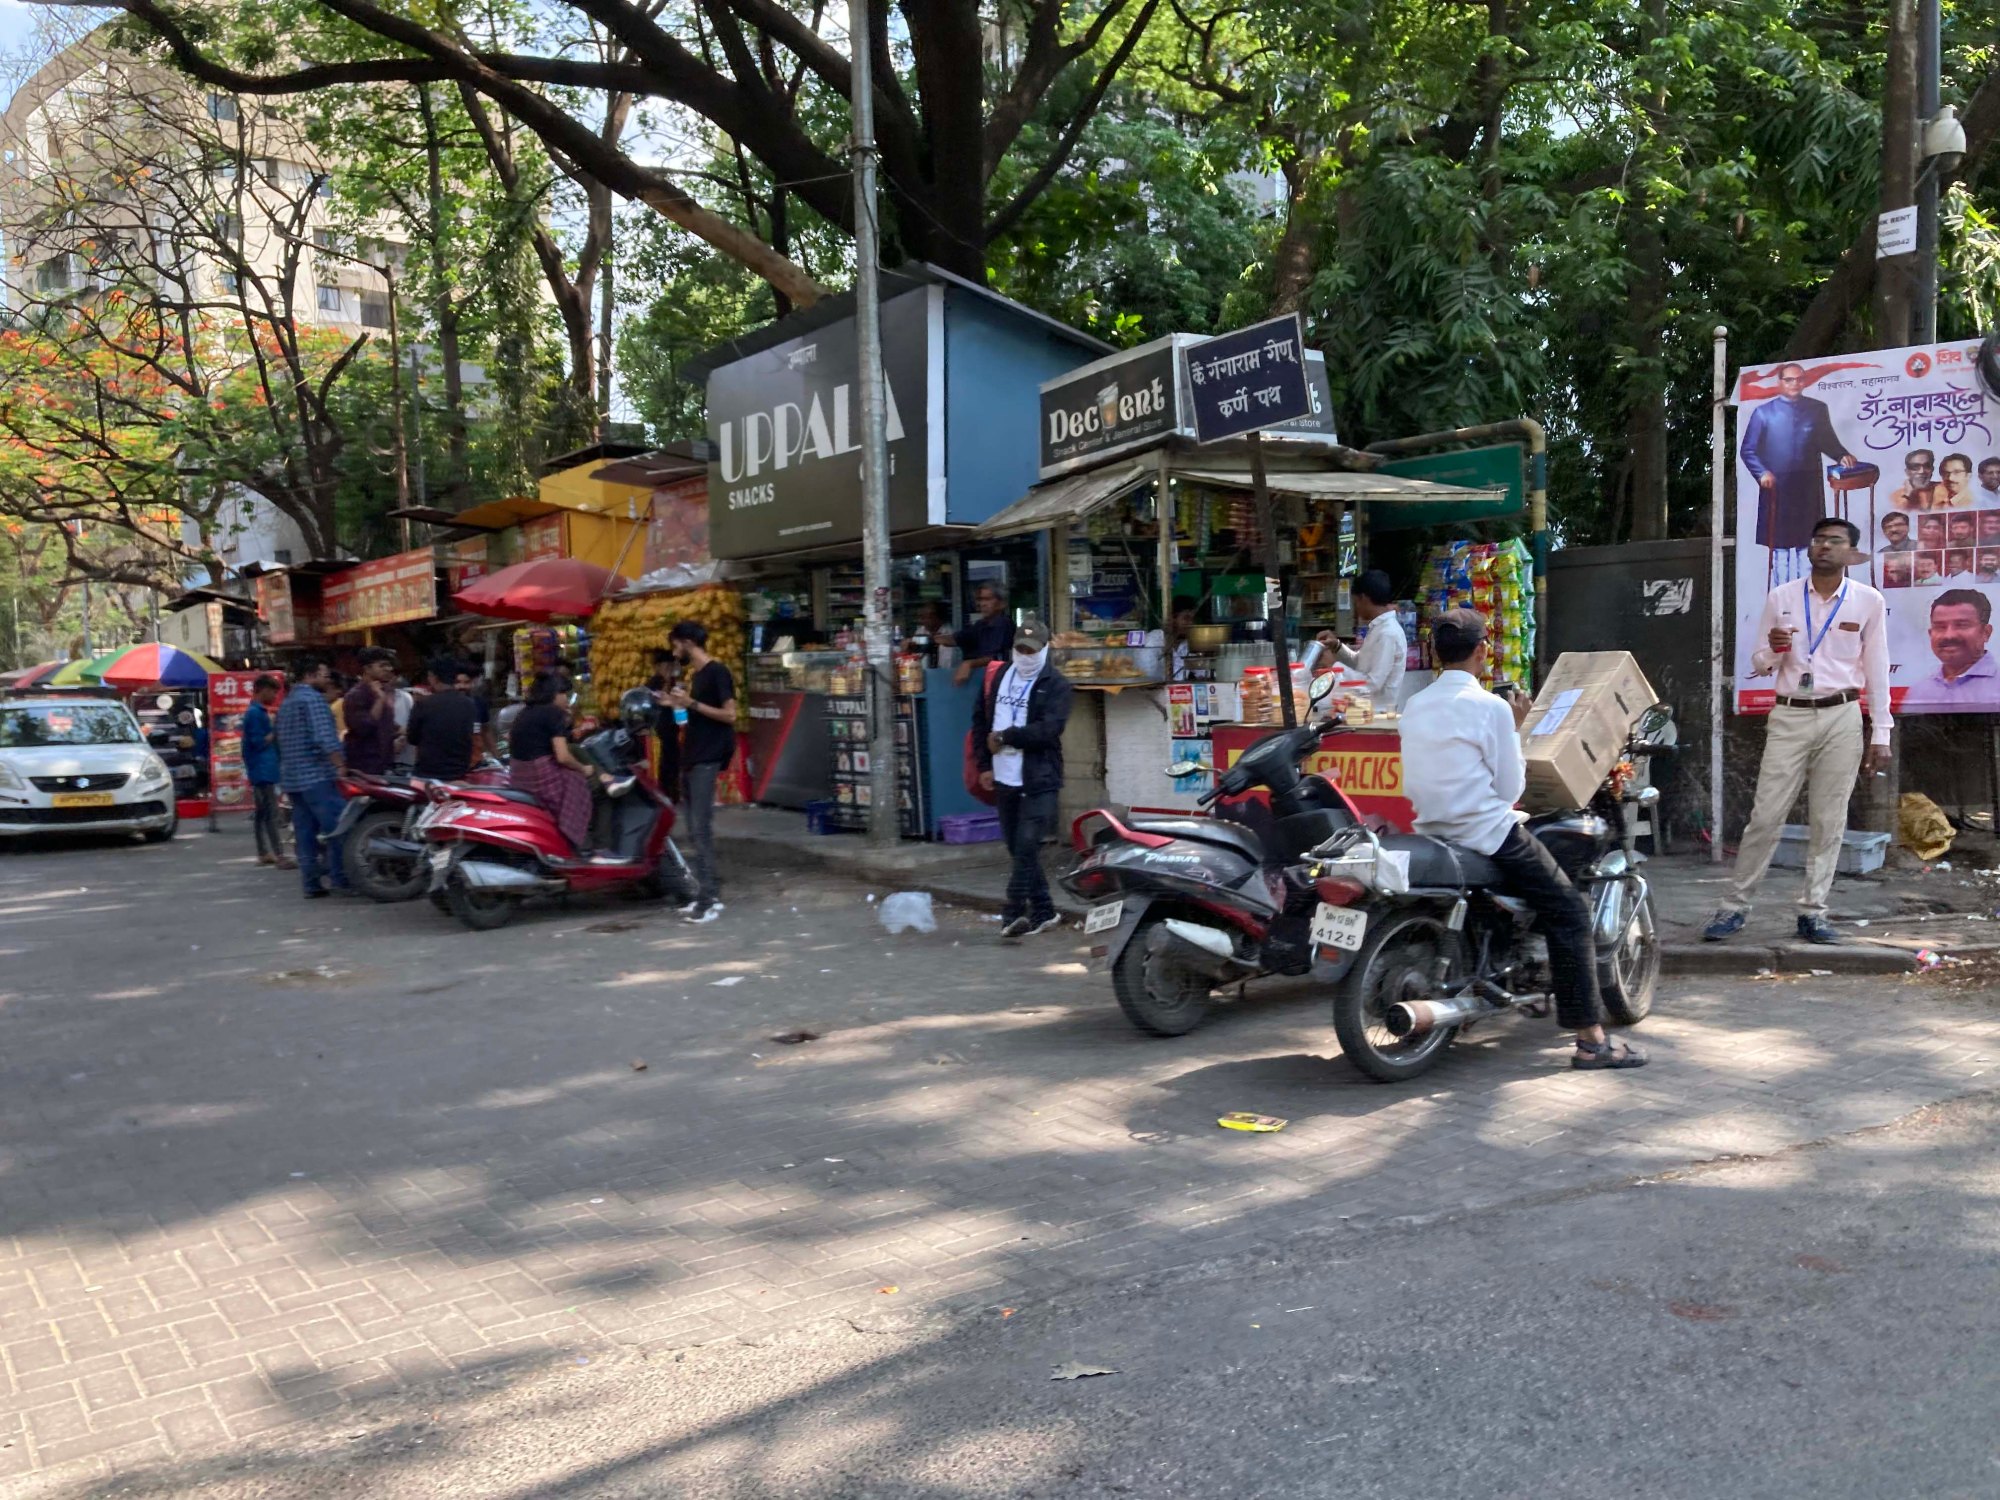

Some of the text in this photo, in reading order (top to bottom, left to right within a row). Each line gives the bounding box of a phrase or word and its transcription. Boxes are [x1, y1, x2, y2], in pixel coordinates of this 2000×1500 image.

[1206, 349, 1261, 381] गंगाराम
[1264, 339, 1299, 364] गेणू
[1861, 374, 1900, 387] महामानव
[1218, 386, 1249, 418] कर्णे
[1253, 385, 1282, 408] पथ
[1144, 418, 1163, 431] Store
[1300, 418, 1321, 428] Store
[728, 482, 775, 511] SNACKS
[214, 676, 239, 696] श्री
[835, 701, 872, 716] UPPAL
[1144, 852, 1202, 865] Pleasure
[1316, 928, 1356, 946] 4125
